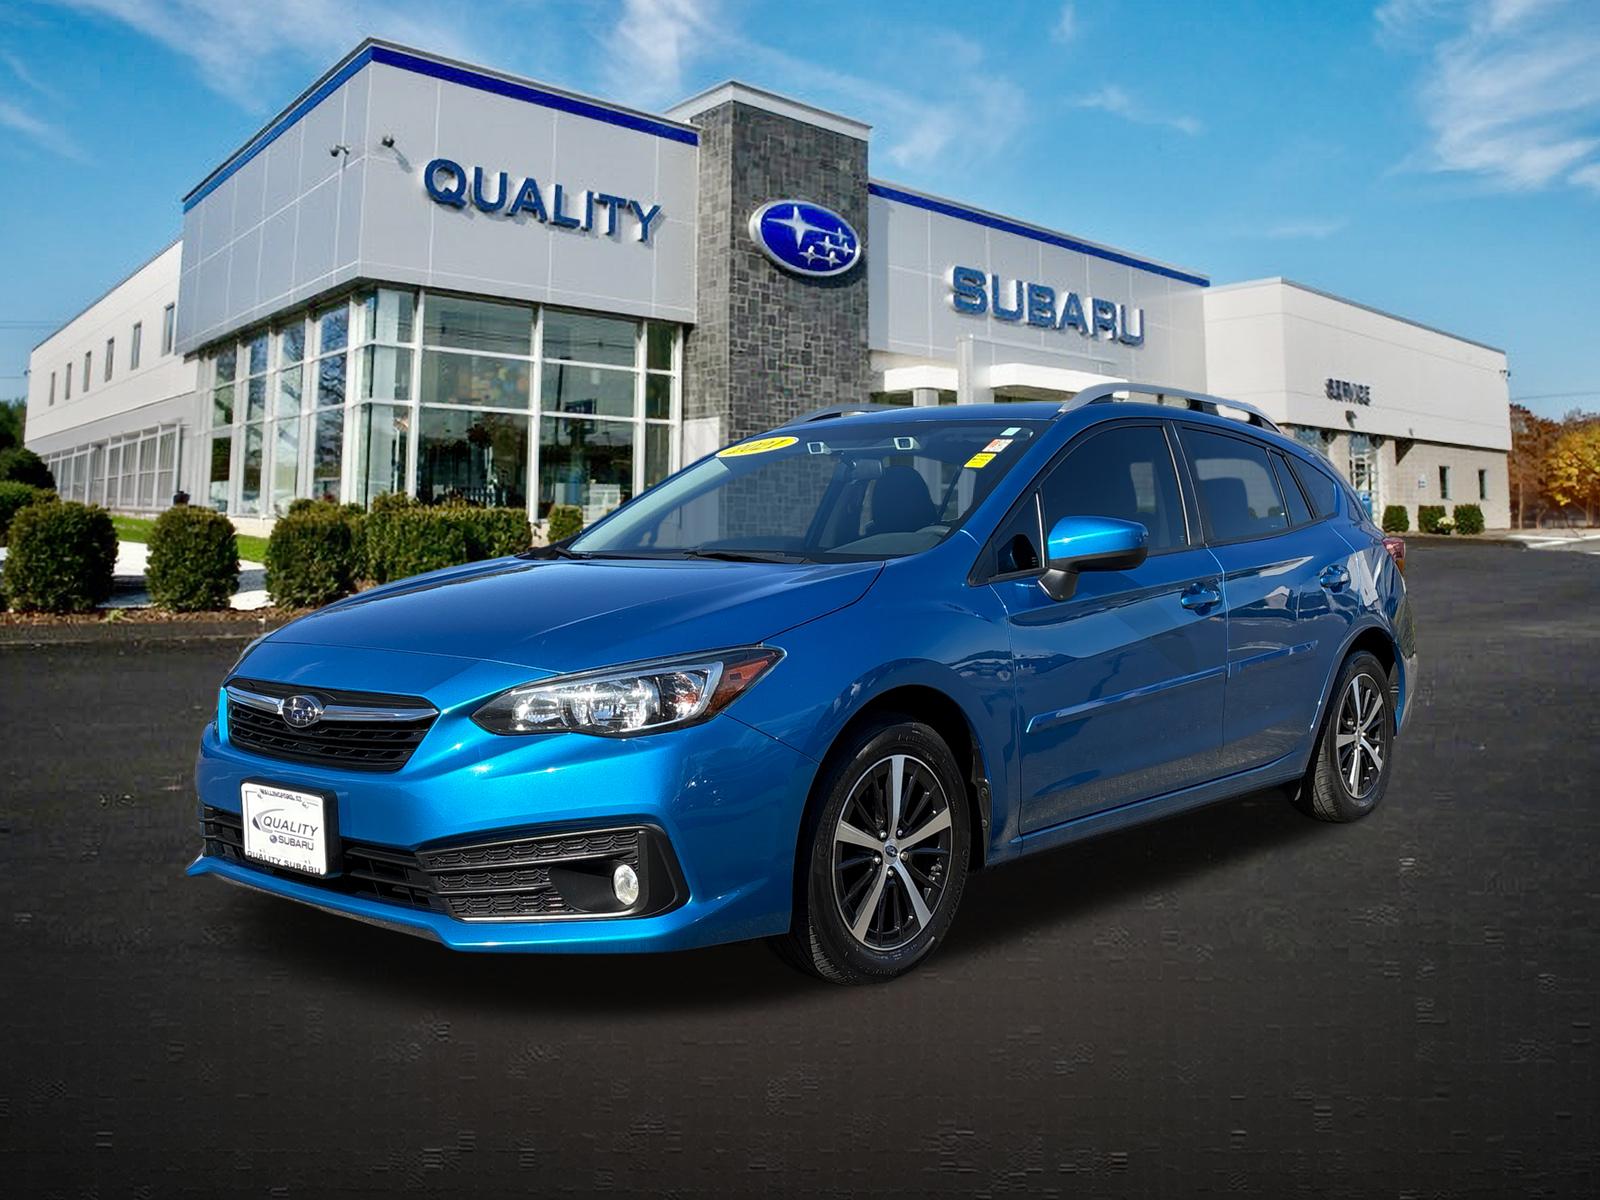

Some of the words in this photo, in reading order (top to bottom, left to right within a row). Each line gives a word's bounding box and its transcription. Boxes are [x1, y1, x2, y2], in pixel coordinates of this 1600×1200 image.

[423, 158, 662, 243] QUALITY
[951, 265, 1145, 347] SUBARU
[1324, 378, 1371, 407] SERVICE
[263, 815, 319, 837] QUALITY
[278, 835, 315, 852] SUBARU
[247, 850, 281, 866] QUALITY
[284, 860, 321, 874] SUBARU
